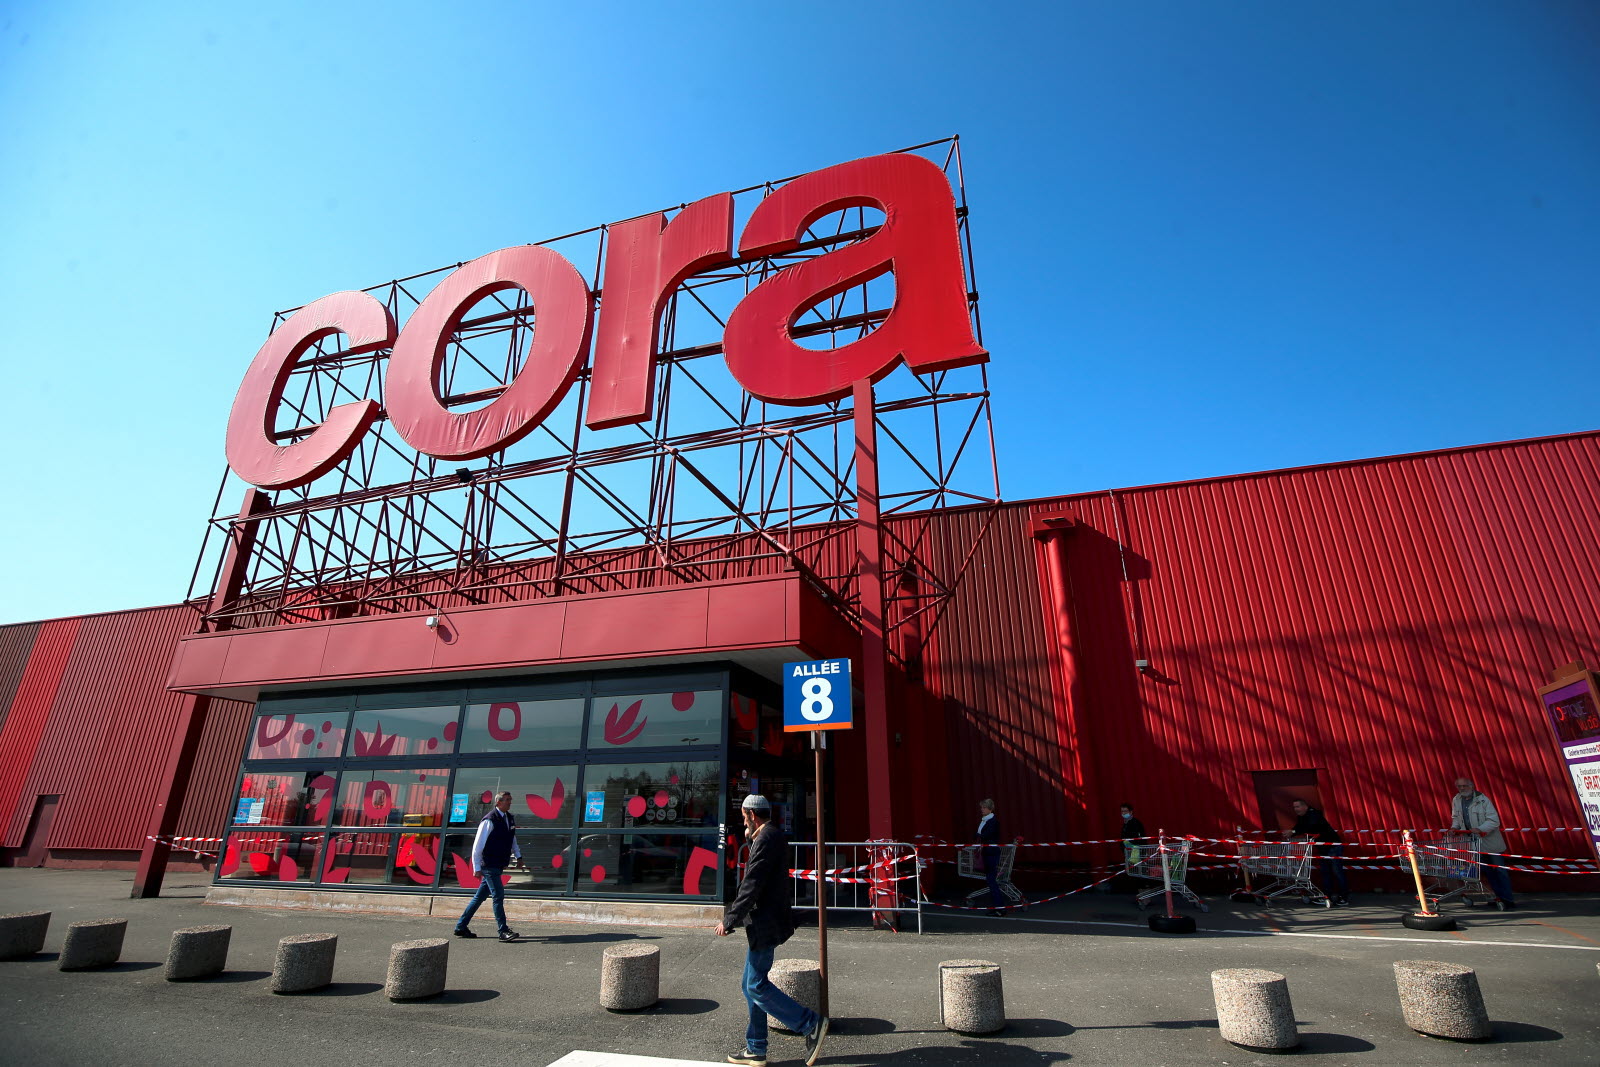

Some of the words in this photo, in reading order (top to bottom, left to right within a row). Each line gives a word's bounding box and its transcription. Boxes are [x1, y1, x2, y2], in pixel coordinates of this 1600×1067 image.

[224, 152, 990, 490] cora
[793, 661, 841, 677] ALLÉE
[801, 677, 834, 721] 8
